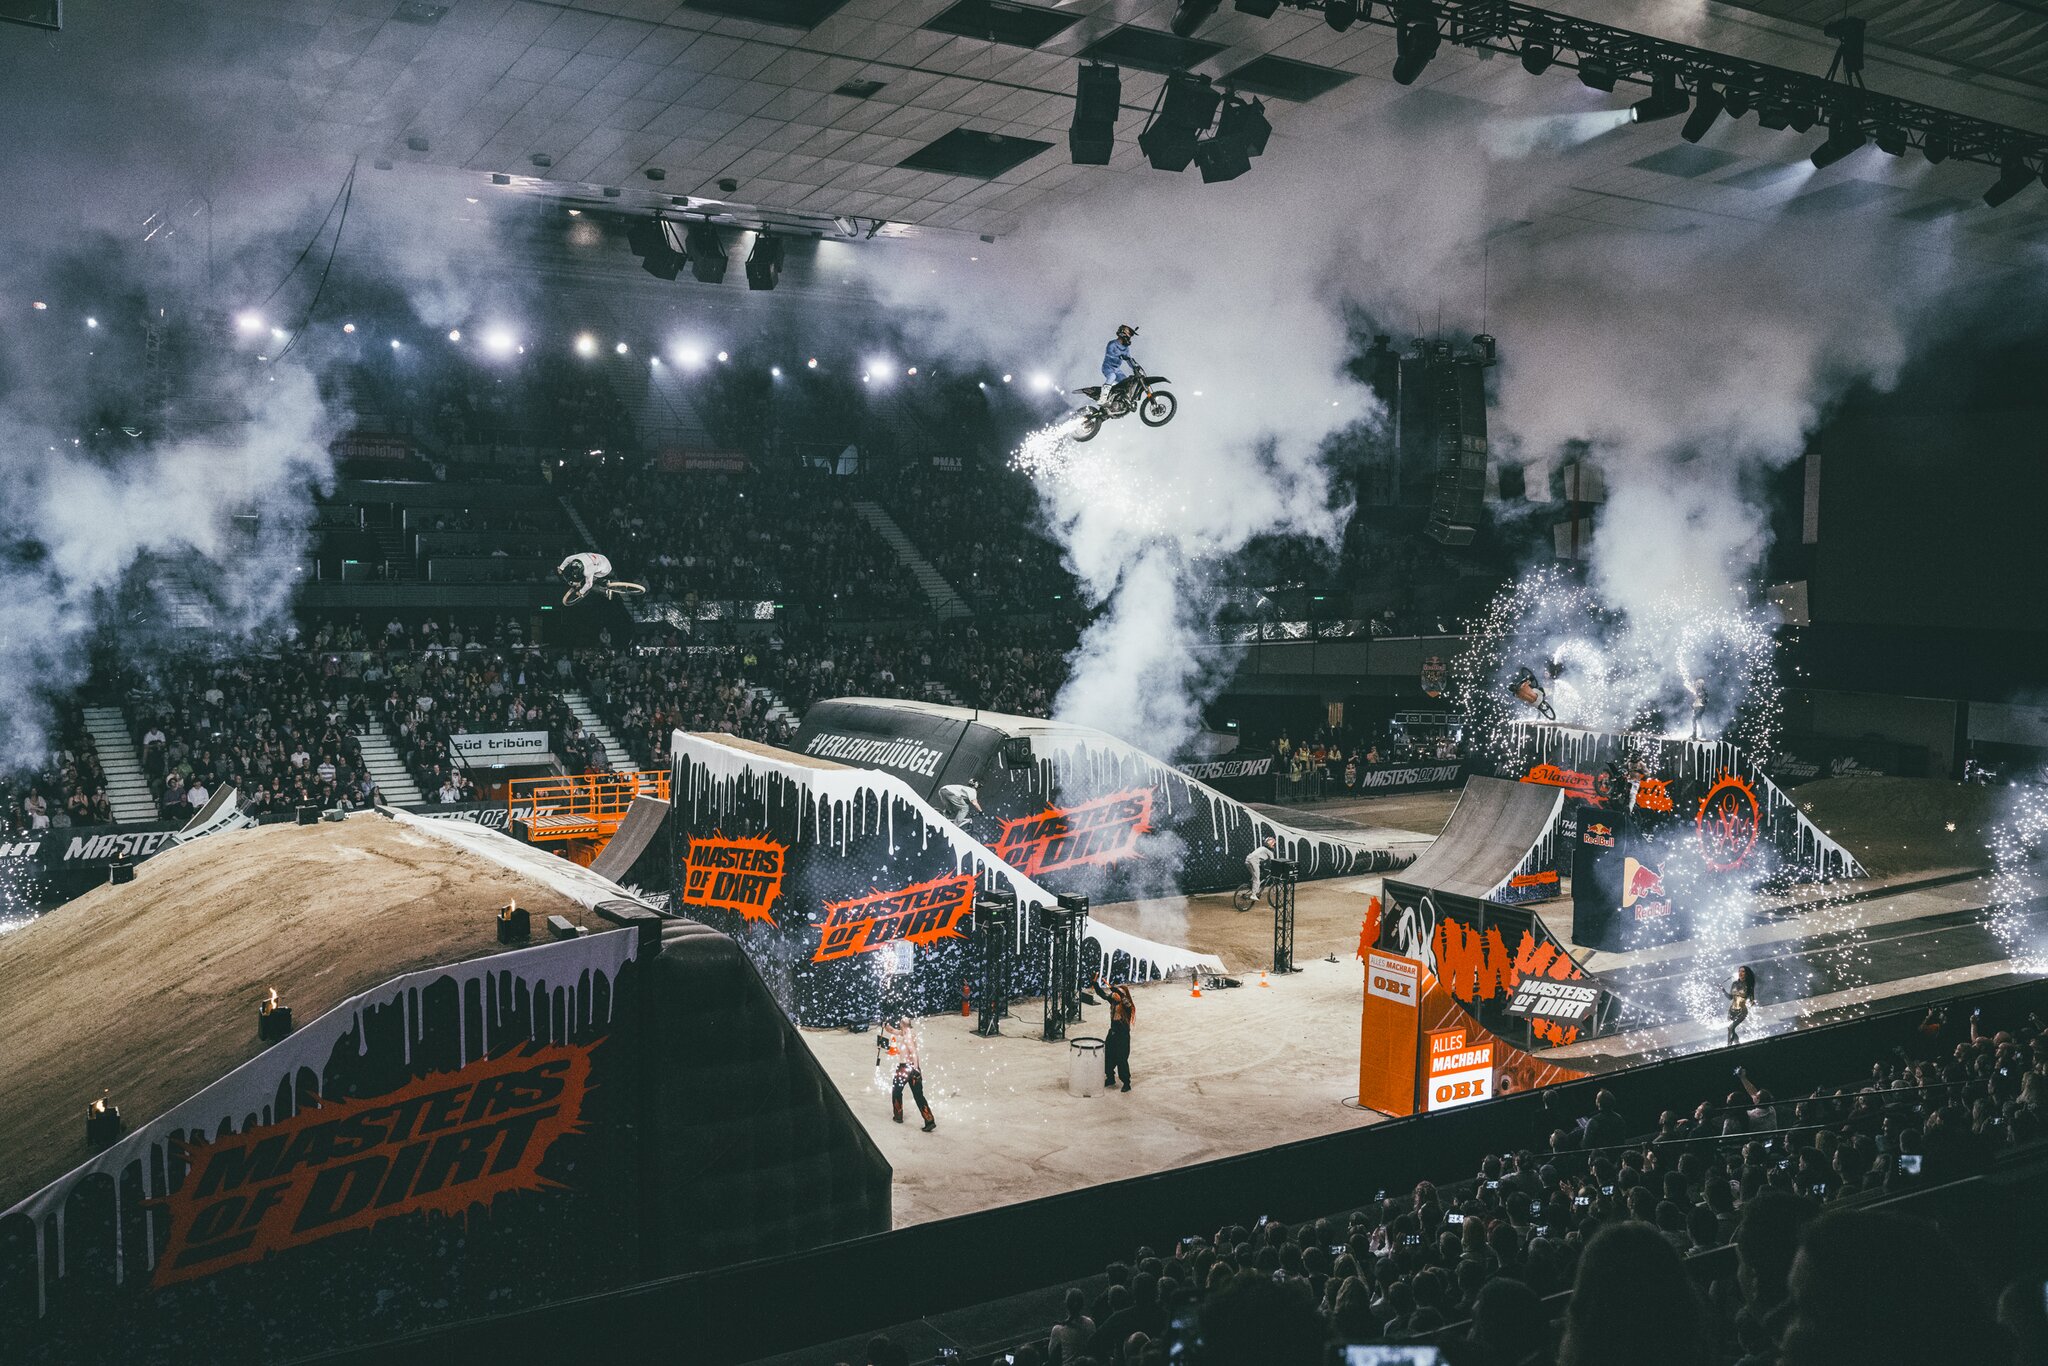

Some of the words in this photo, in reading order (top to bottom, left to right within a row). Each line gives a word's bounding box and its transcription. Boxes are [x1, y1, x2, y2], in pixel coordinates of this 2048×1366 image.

[933, 457, 962, 466] DMAX
[456, 737, 482, 750] süd
[488, 737, 542, 749] tribüne
[1222, 761, 1242, 777] OF
[1239, 758, 1271, 777] DIRT
[1362, 768, 1419, 788] MASTERS
[1417, 767, 1434, 783] OF
[1431, 764, 1461, 782] DIRT
[1532, 768, 1589, 785] Masters
[1004, 796, 1145, 847] MASTERS
[64, 831, 179, 861] MASTE
[1003, 845, 1038, 867] OF
[1041, 818, 1141, 867] DIRT
[690, 844, 779, 874] MASTERS
[688, 870, 712, 890] OF
[712, 871, 777, 906] DIRT
[831, 880, 968, 926] MASTERS
[826, 924, 865, 947] OF
[863, 902, 963, 947] DIRT
[1370, 956, 1386, 967] ALLES
[1386, 961, 1417, 976] MACHBAR
[1374, 975, 1411, 997] OBI
[1518, 980, 1598, 1002] MASTERS
[1511, 994, 1536, 1008] OF
[1532, 998, 1594, 1019] DIRT
[1433, 1034, 1463, 1054] ALLES
[1432, 1048, 1490, 1073] MACHBAR
[1435, 1079, 1485, 1103] OBI
[192, 1059, 573, 1199] MASTERS
[186, 1180, 296, 1245] OF
[291, 1103, 563, 1235] DIRT
